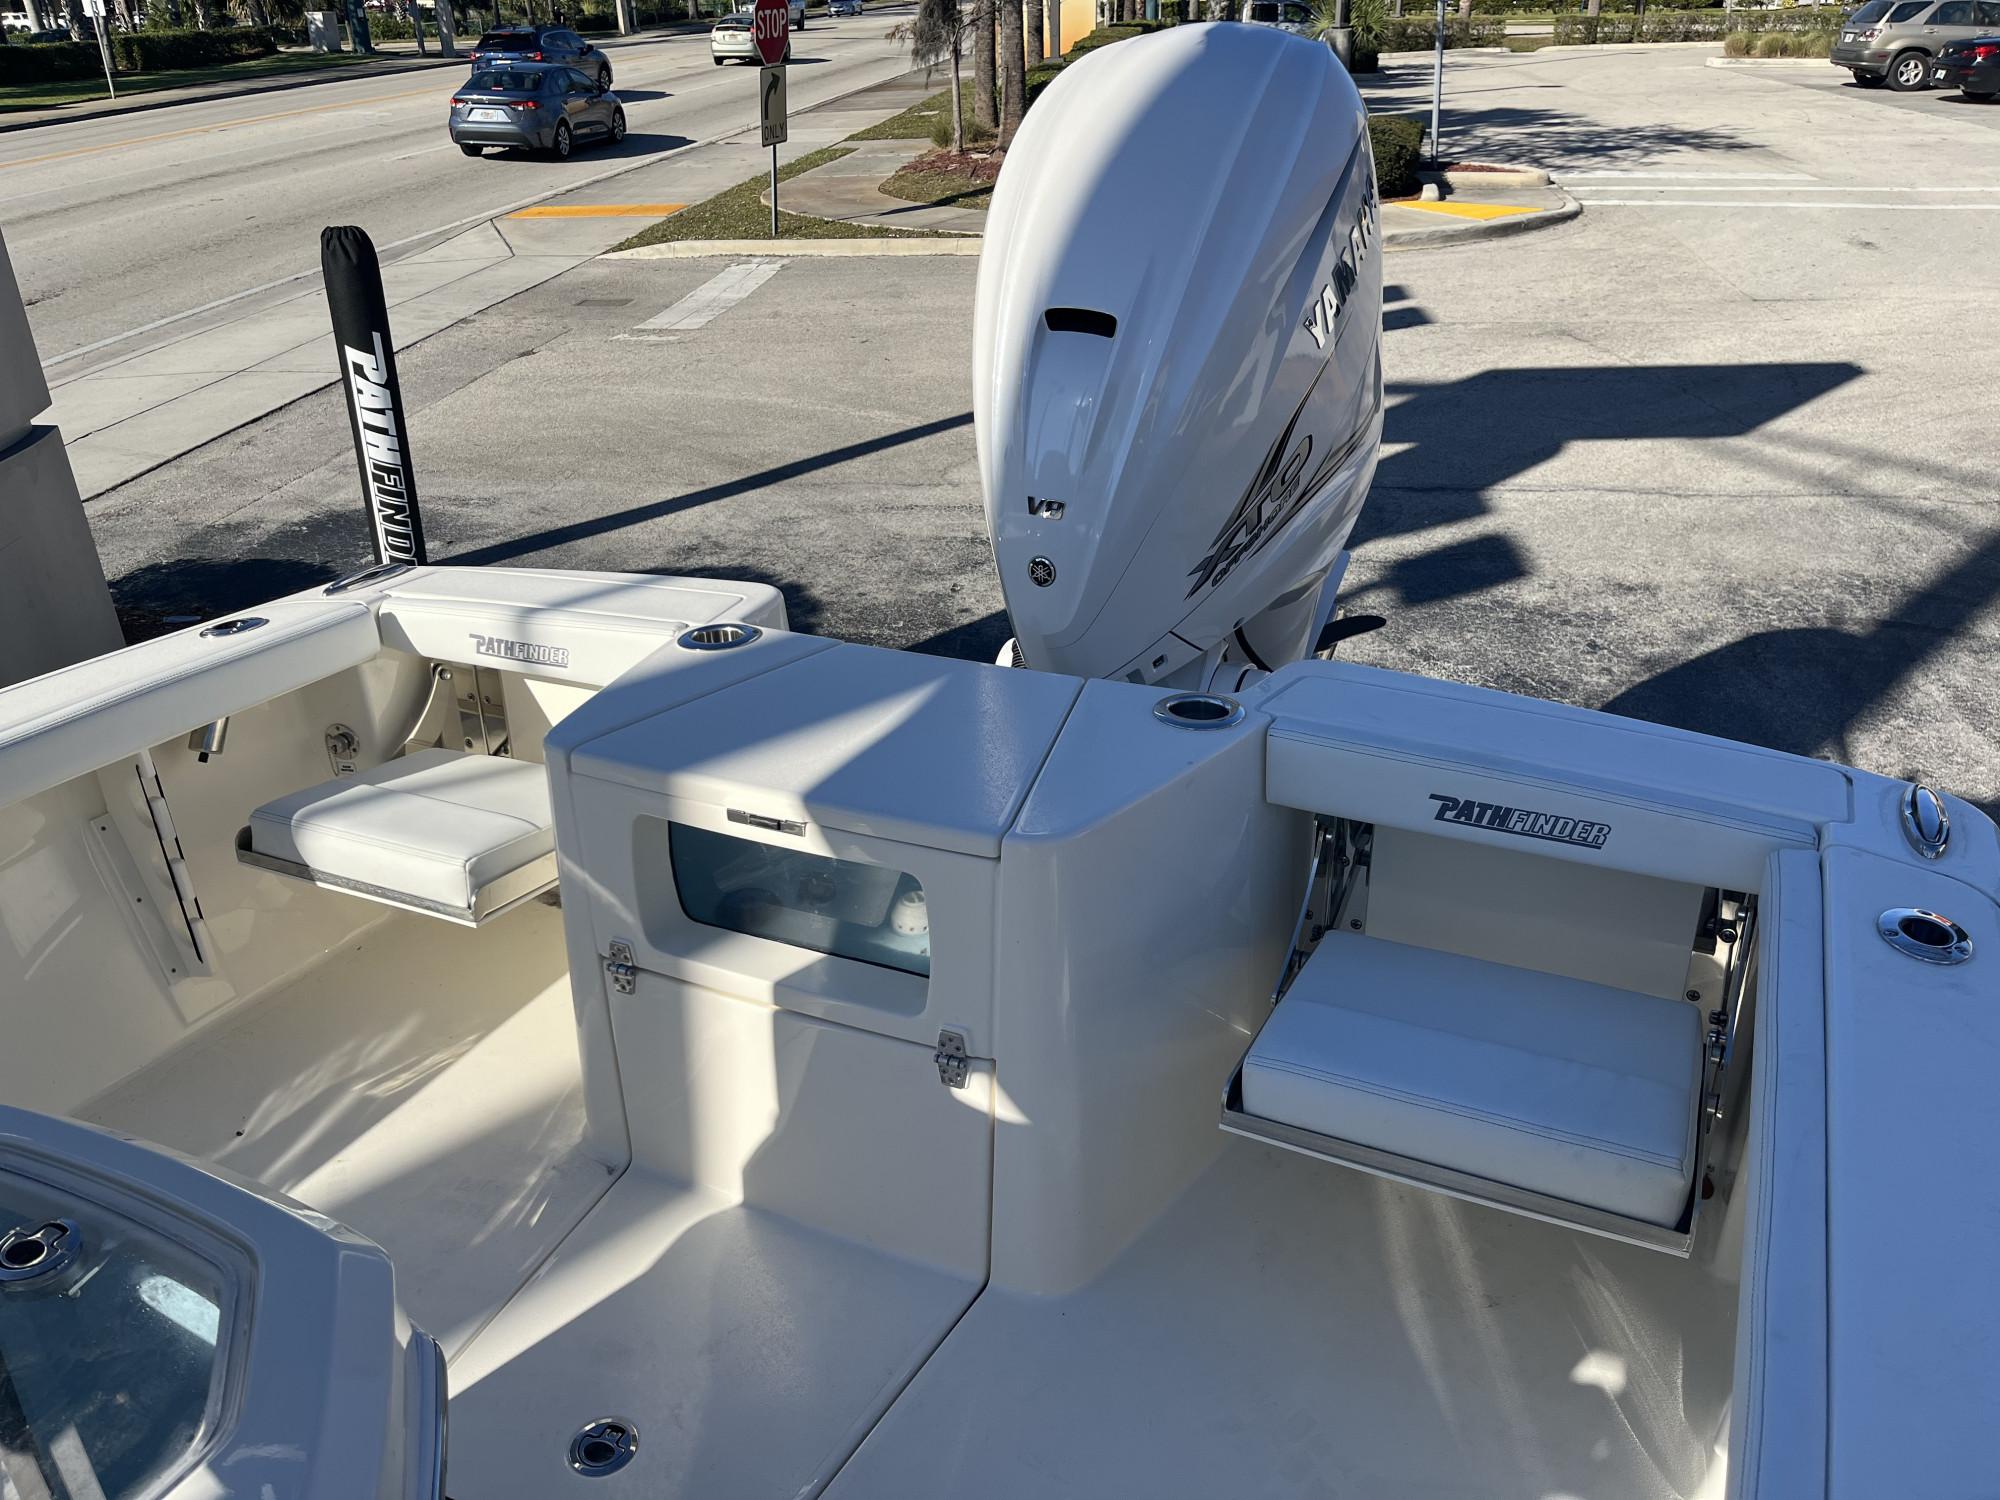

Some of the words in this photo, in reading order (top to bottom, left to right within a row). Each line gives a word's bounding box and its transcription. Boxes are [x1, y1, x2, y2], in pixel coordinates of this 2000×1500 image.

[757, 8, 787, 39] STOP
[764, 122, 785, 141] ONLY
[344, 332, 418, 566] PATHFIND
[1027, 496, 1065, 520] V8
[1184, 434, 1313, 600] XTO
[469, 633, 569, 668] PATHFINDER
[1429, 793, 1611, 849] PATHFINDER
